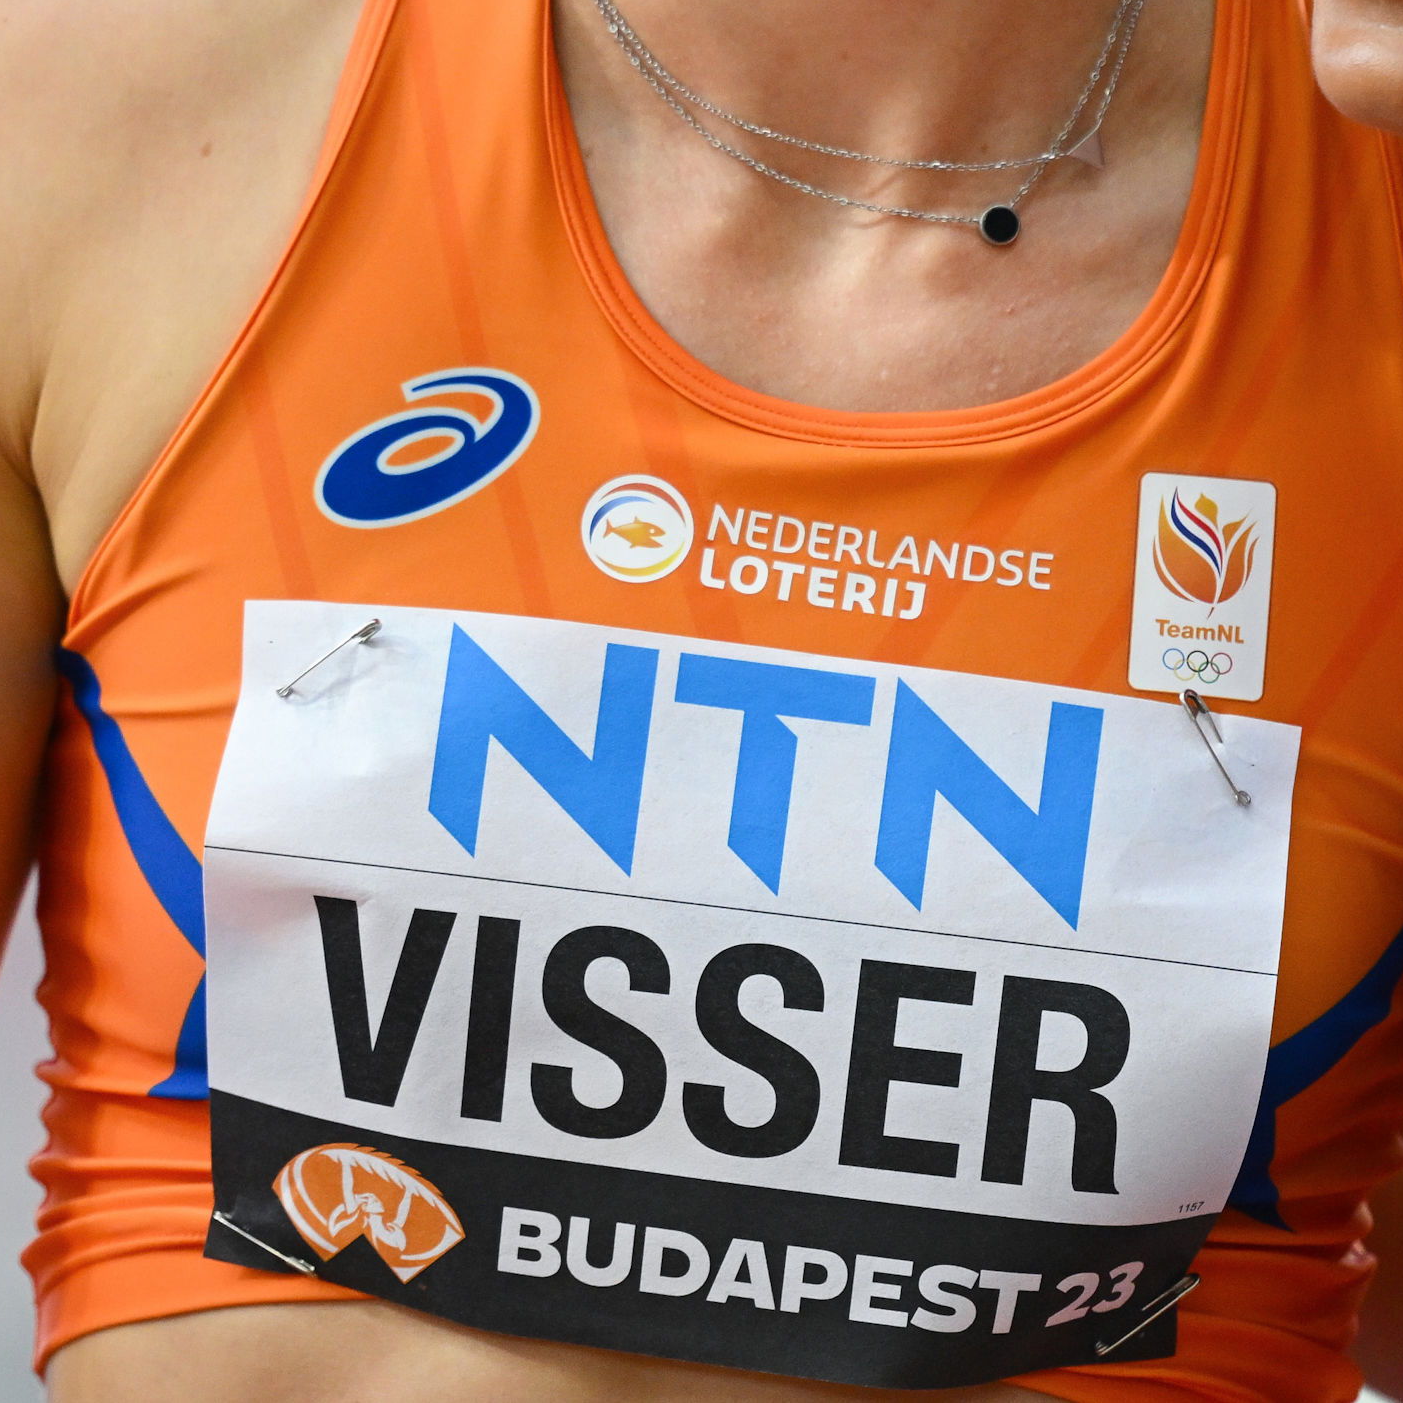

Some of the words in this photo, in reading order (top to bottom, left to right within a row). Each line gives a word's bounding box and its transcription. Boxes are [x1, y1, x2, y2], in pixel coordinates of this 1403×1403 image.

[699, 547, 927, 620] LOTERIJ
[706, 503, 1054, 591] NEDERLANDSE
[1154, 618, 1245, 645] TeamNL
[428, 621, 1105, 933] NTN
[312, 894, 1132, 1196] VISSER
[497, 1205, 1042, 1335] BUDAPEST
[1044, 1260, 1144, 1328] 23
